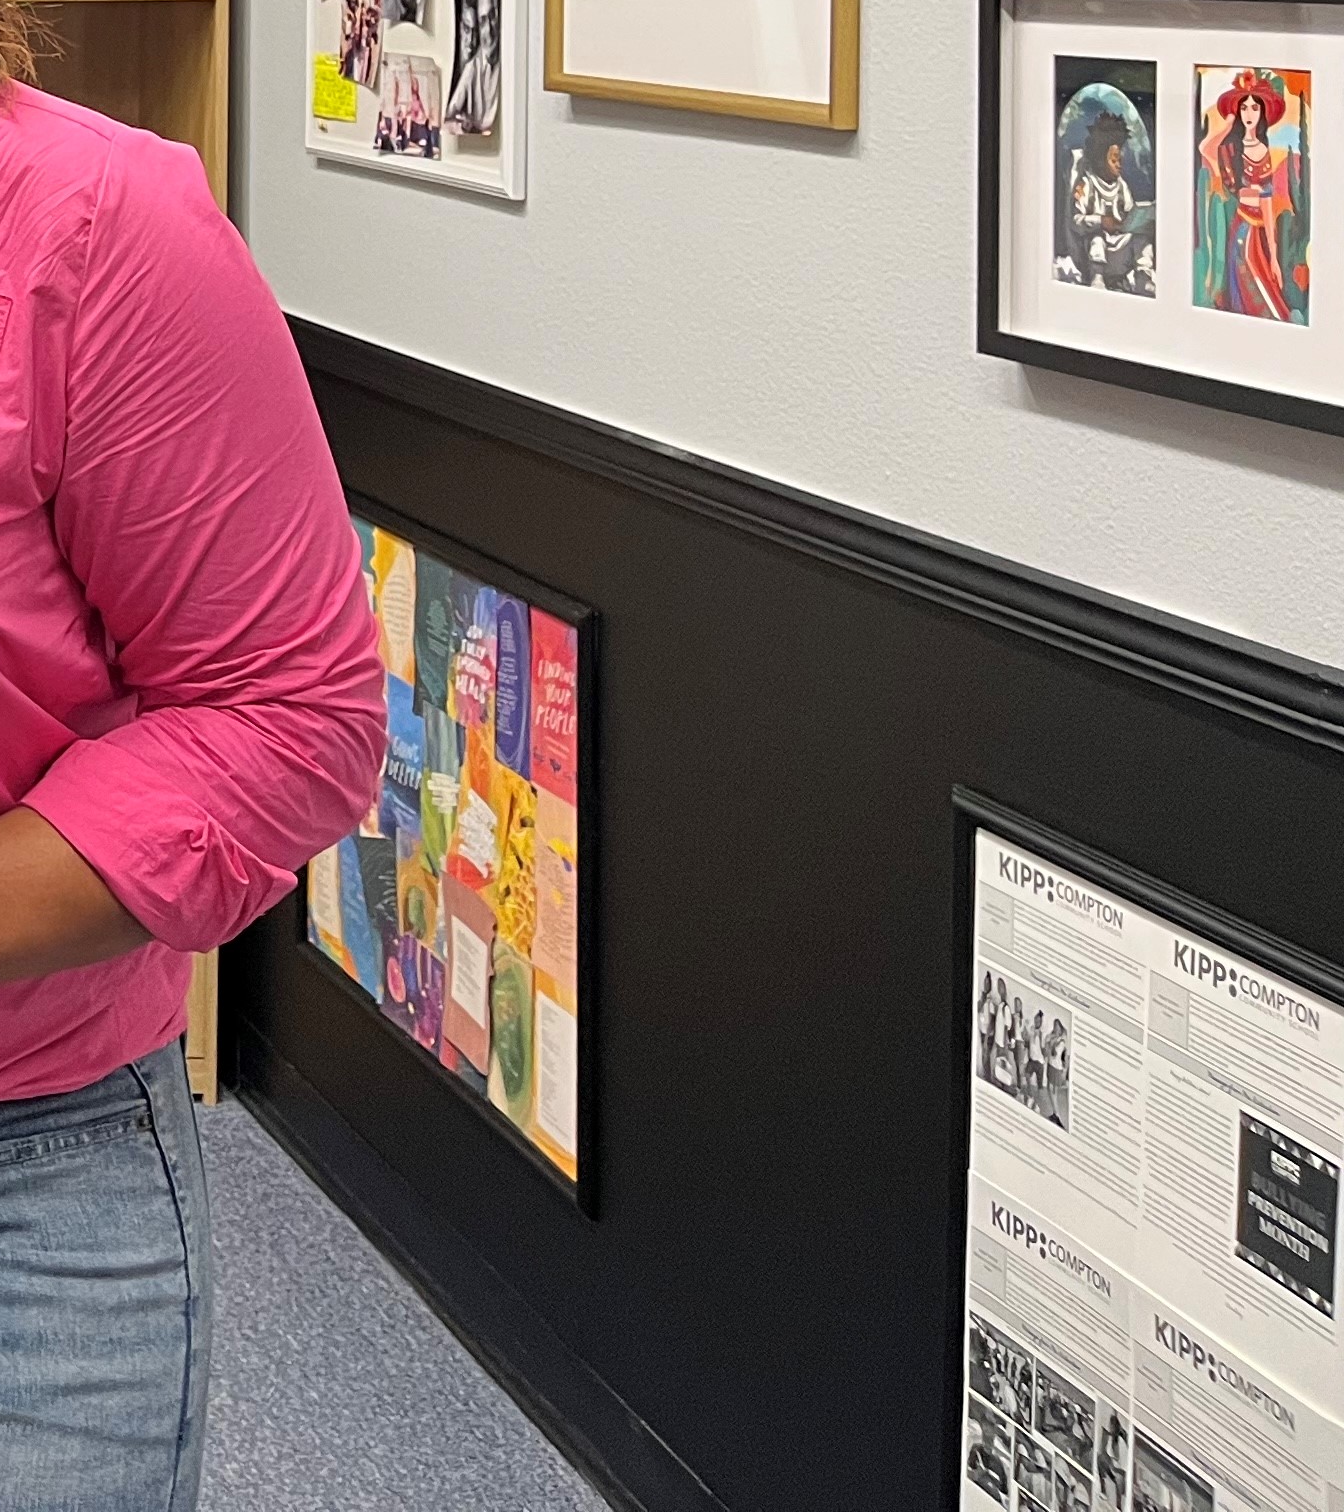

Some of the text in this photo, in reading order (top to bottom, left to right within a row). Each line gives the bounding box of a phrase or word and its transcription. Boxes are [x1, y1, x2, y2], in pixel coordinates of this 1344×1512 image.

[535, 705, 577, 735] PEOPLE
[1055, 881, 1124, 930] COMPTON
[1239, 975, 1320, 1032] COMPTON
[1247, 1188, 1330, 1255] PREVENTION
[1048, 1239, 1112, 1299] COMPTON
[1217, 1360, 1297, 1434] COMPTON
